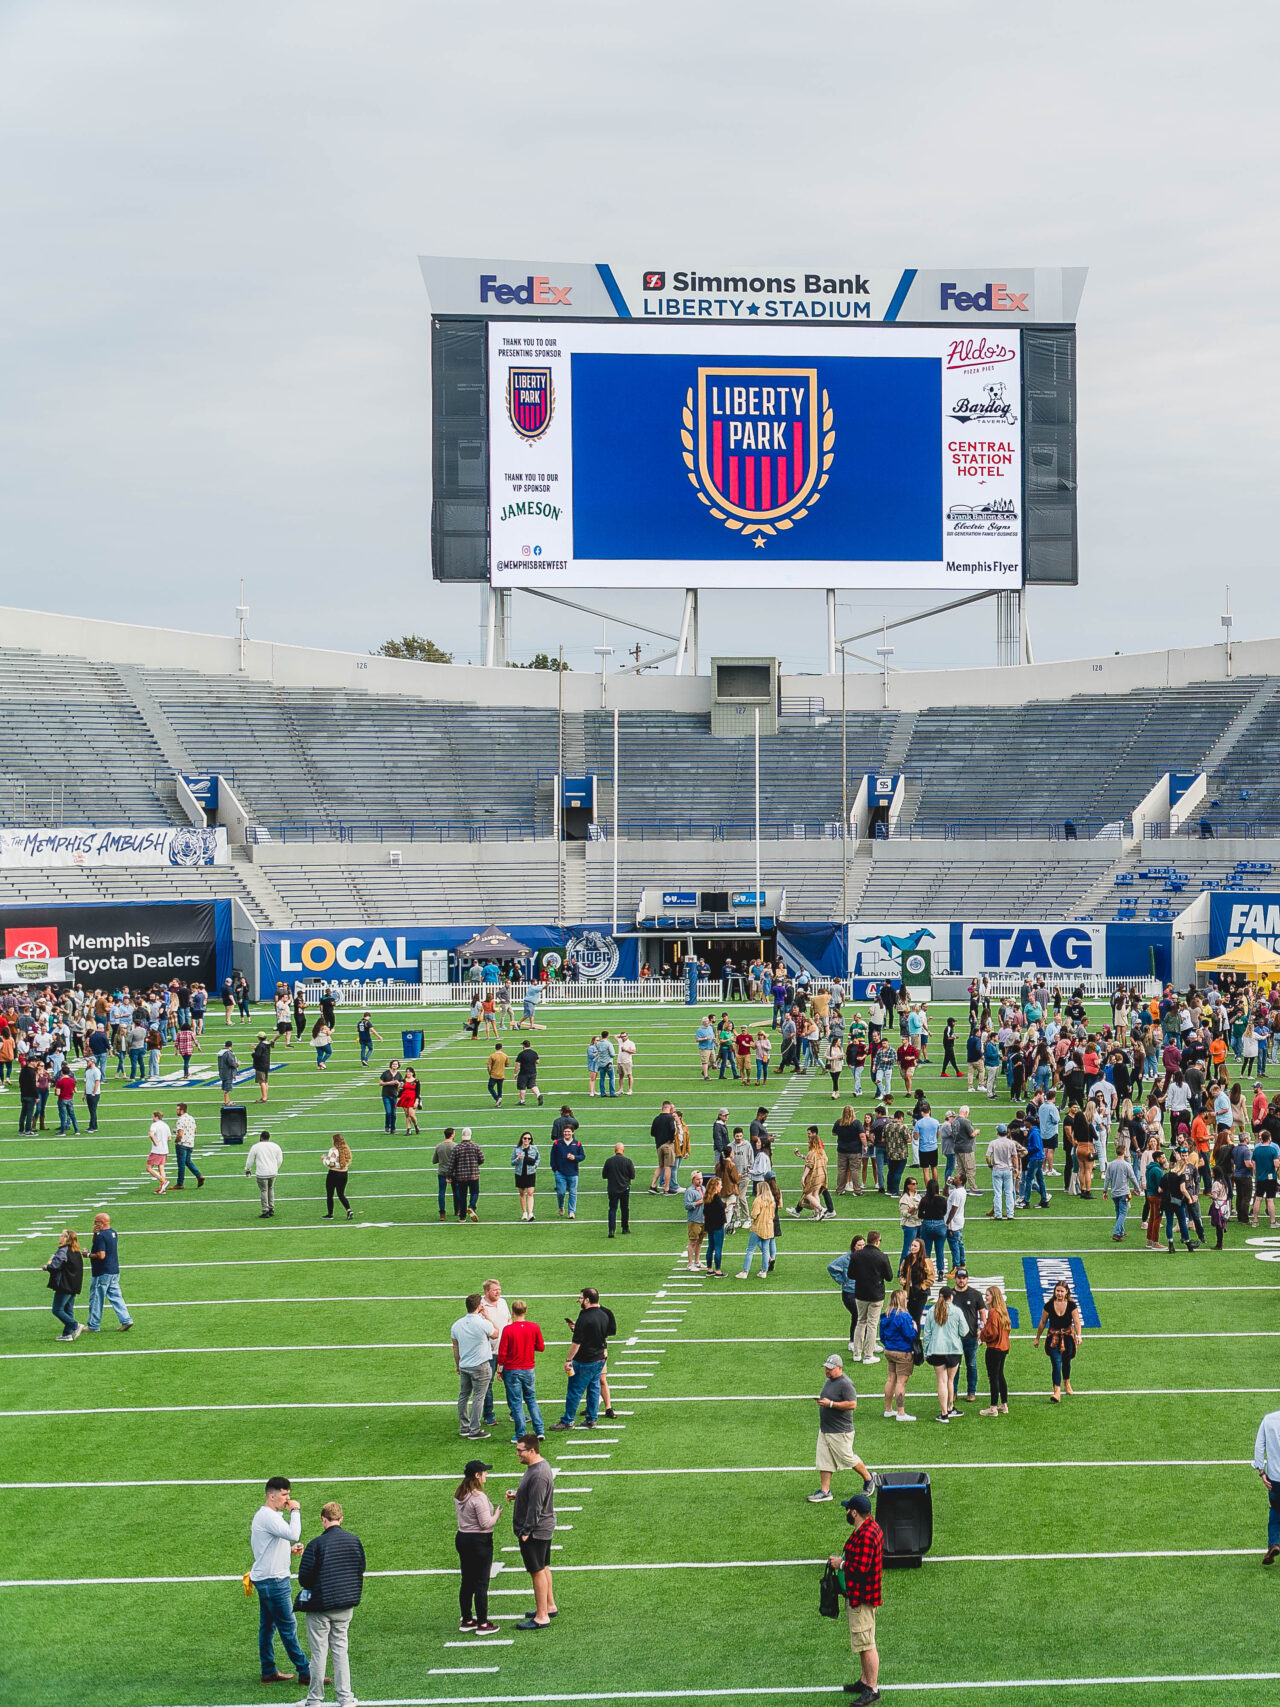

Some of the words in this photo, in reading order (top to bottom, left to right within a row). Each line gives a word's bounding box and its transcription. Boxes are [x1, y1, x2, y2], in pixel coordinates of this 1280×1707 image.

[480, 274, 572, 305] FedEx
[672, 272, 796, 293] Simmons
[804, 274, 870, 294] Bank
[940, 282, 1030, 311] FedEx
[644, 298, 744, 316] LIBERTY
[765, 300, 871, 318] STADIUM
[502, 338, 521, 346] THANK
[523, 338, 534, 346] YOU
[947, 338, 1015, 364] Aldo's
[498, 349, 533, 357] PRESENTING
[515, 375, 546, 388] LIBERTY
[520, 390, 540, 403] PARK
[712, 386, 804, 416] LIBERTY
[952, 398, 1011, 418] Bardog
[730, 421, 787, 450] PARK
[948, 442, 1015, 452] CENTRAL
[952, 454, 1012, 464] STATION
[958, 466, 1004, 476] HOTEL
[512, 484, 522, 492] VIP
[501, 502, 560, 521] JAMESON
[954, 522, 985, 531] Electric
[988, 522, 1011, 531] Signs
[497, 560, 567, 572] @MEMPHISBREWFEST
[24, 833, 98, 856] MEMPHIS
[96, 832, 167, 856] AMBUSH
[69, 932, 150, 951] Memphis
[970, 928, 1092, 969] TAG
[69, 955, 128, 975] Toyota
[134, 952, 200, 969] Dealers
[281, 937, 418, 971] LOCAL
[574, 951, 610, 966] Tiger
